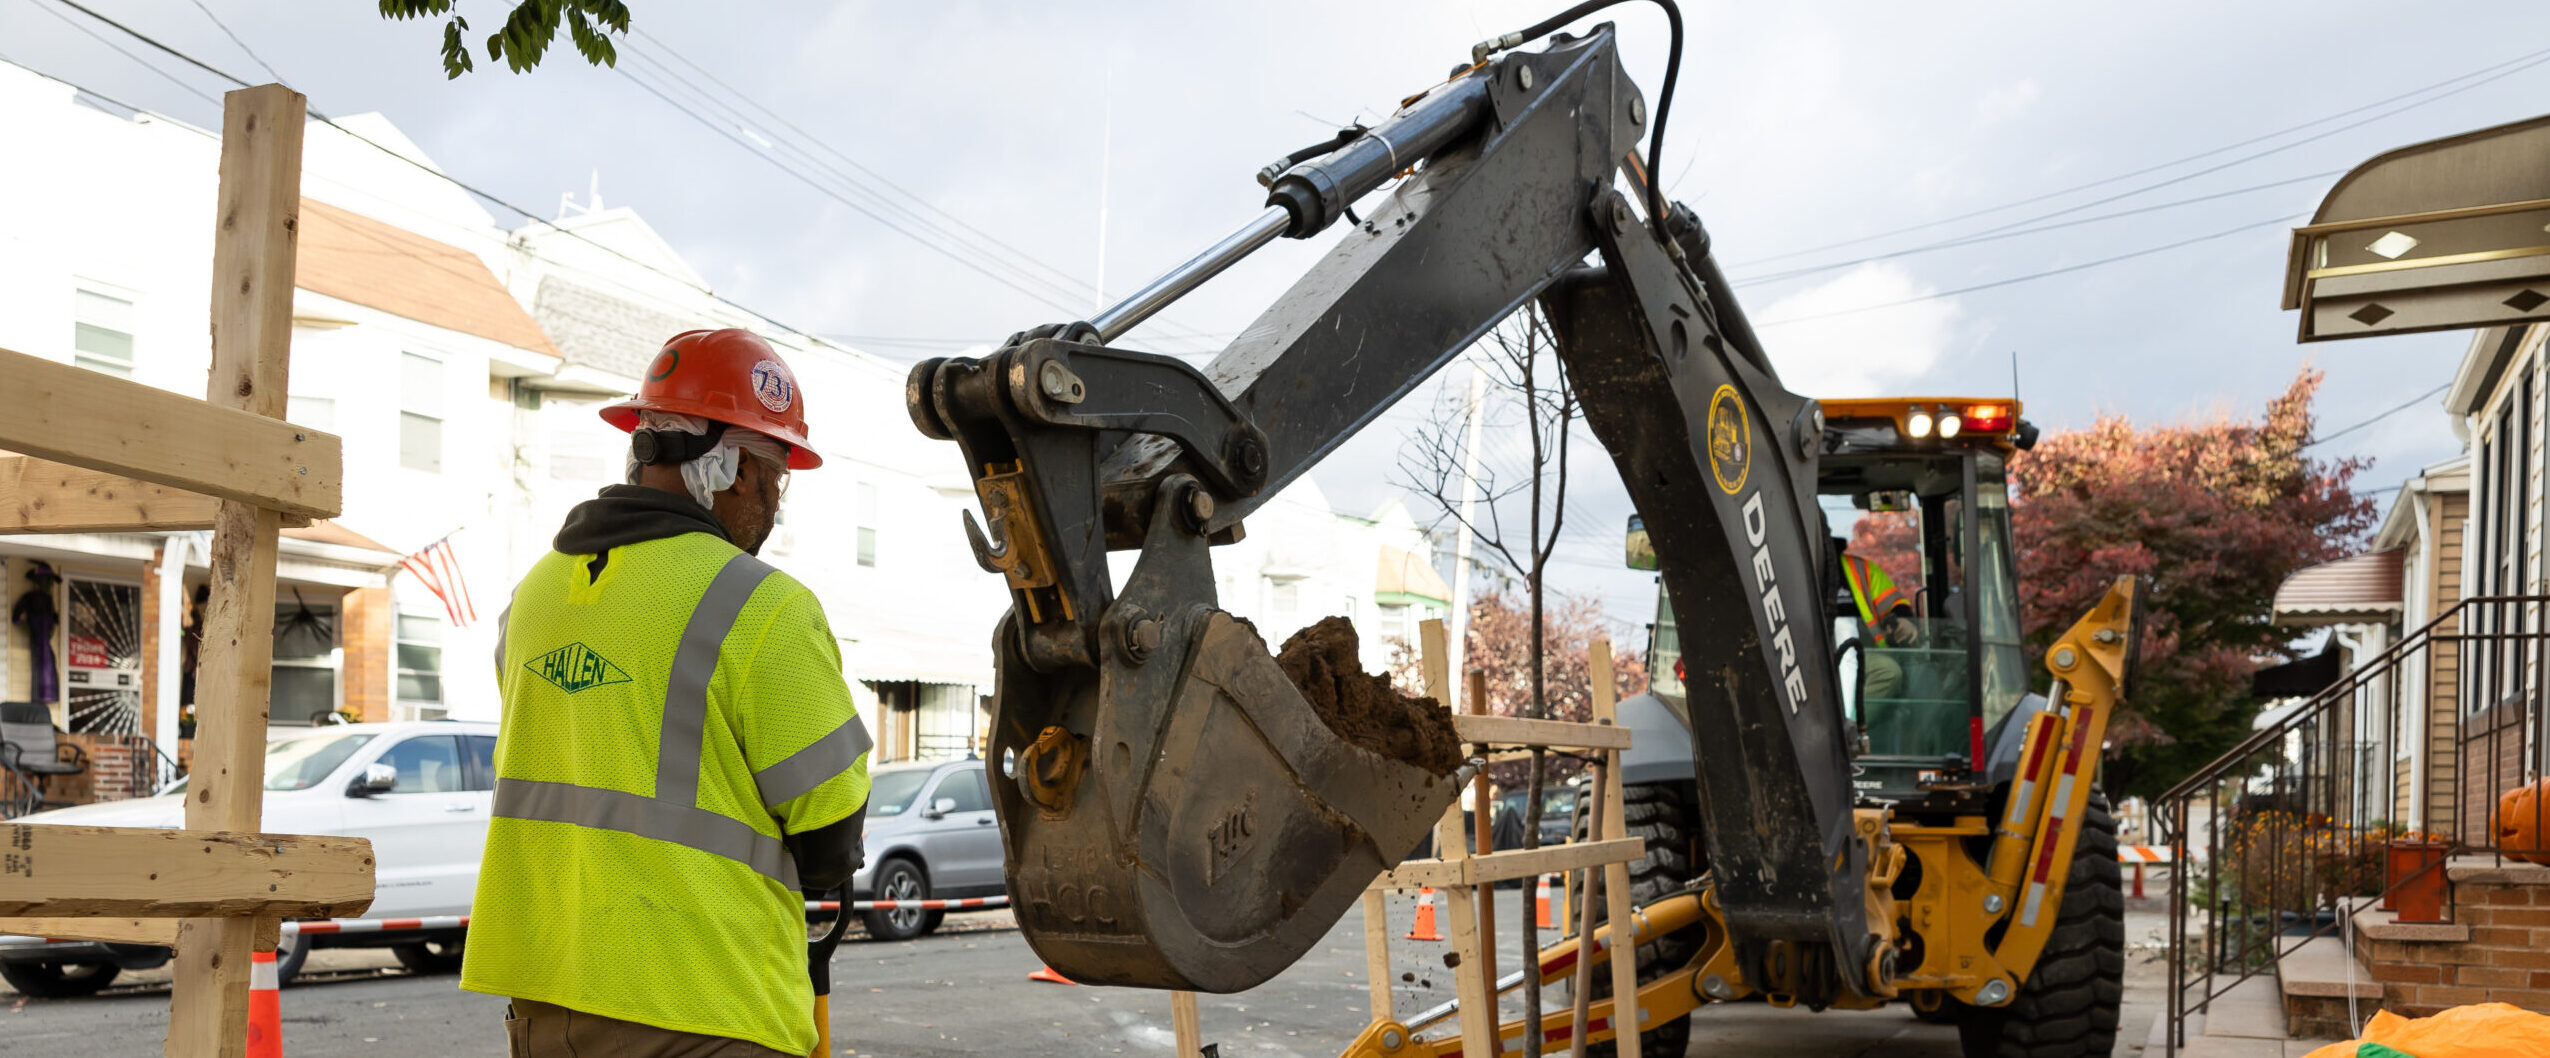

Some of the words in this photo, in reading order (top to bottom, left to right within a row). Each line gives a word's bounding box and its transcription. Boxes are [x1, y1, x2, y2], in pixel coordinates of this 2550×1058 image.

[753, 368, 790, 402] 731
[1742, 491, 1807, 714] DEERE
[543, 645, 606, 690] HALLEN
